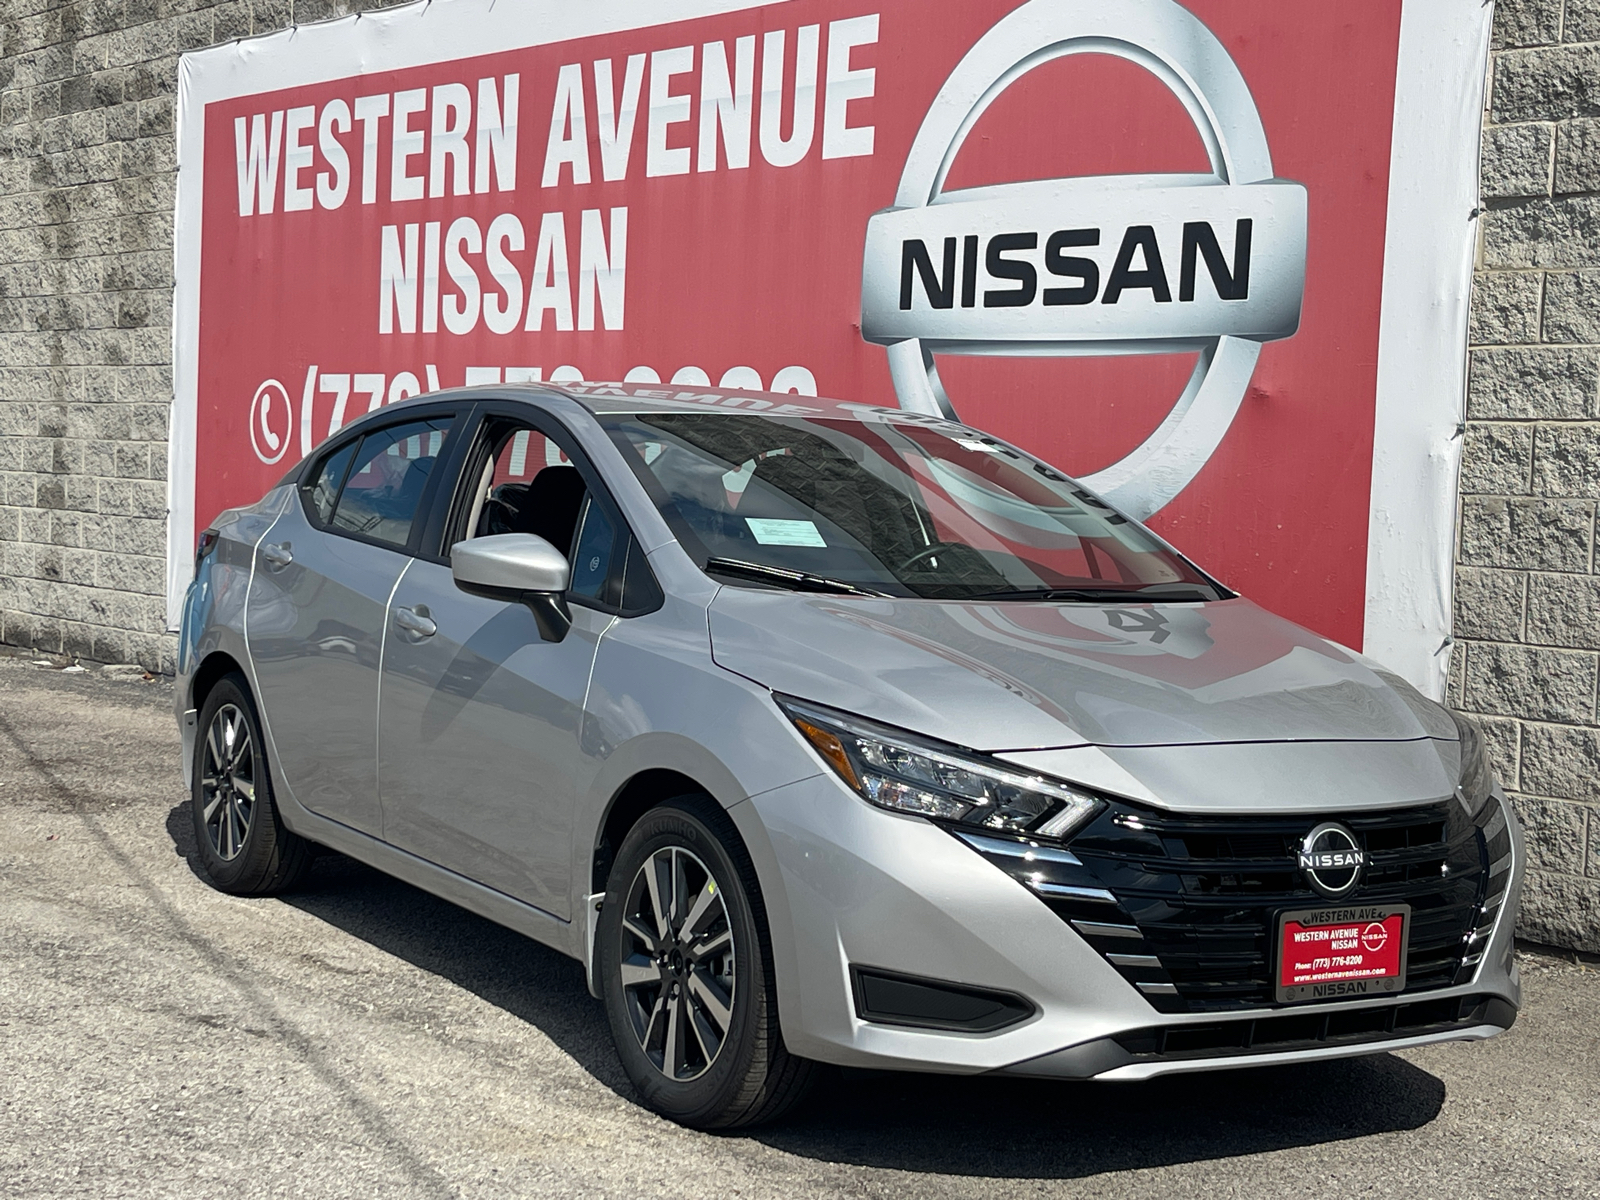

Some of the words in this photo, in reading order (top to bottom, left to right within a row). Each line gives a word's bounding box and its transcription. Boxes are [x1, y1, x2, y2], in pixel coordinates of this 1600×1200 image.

[233, 73, 520, 217] WESTERN
[541, 13, 880, 189] AVENUE
[379, 206, 628, 336] NISSAN
[899, 218, 1253, 311] NISSAN
[650, 817, 697, 841] KUMHO
[1300, 852, 1364, 867] NISSAN
[1310, 910, 1357, 924] WESTERN
[1359, 908, 1377, 919] AVE
[1293, 930, 1329, 942] WESTERN
[1330, 928, 1359, 940] AVENUE
[1361, 933, 1388, 941] NISSAN
[1331, 939, 1358, 950] NISSAN
[1312, 958, 1331, 970] (773)
[1331, 955, 1363, 967] 776-8200
[1294, 967, 1386, 982] www.westernavenissan.com
[1312, 981, 1367, 997] NISSAN
